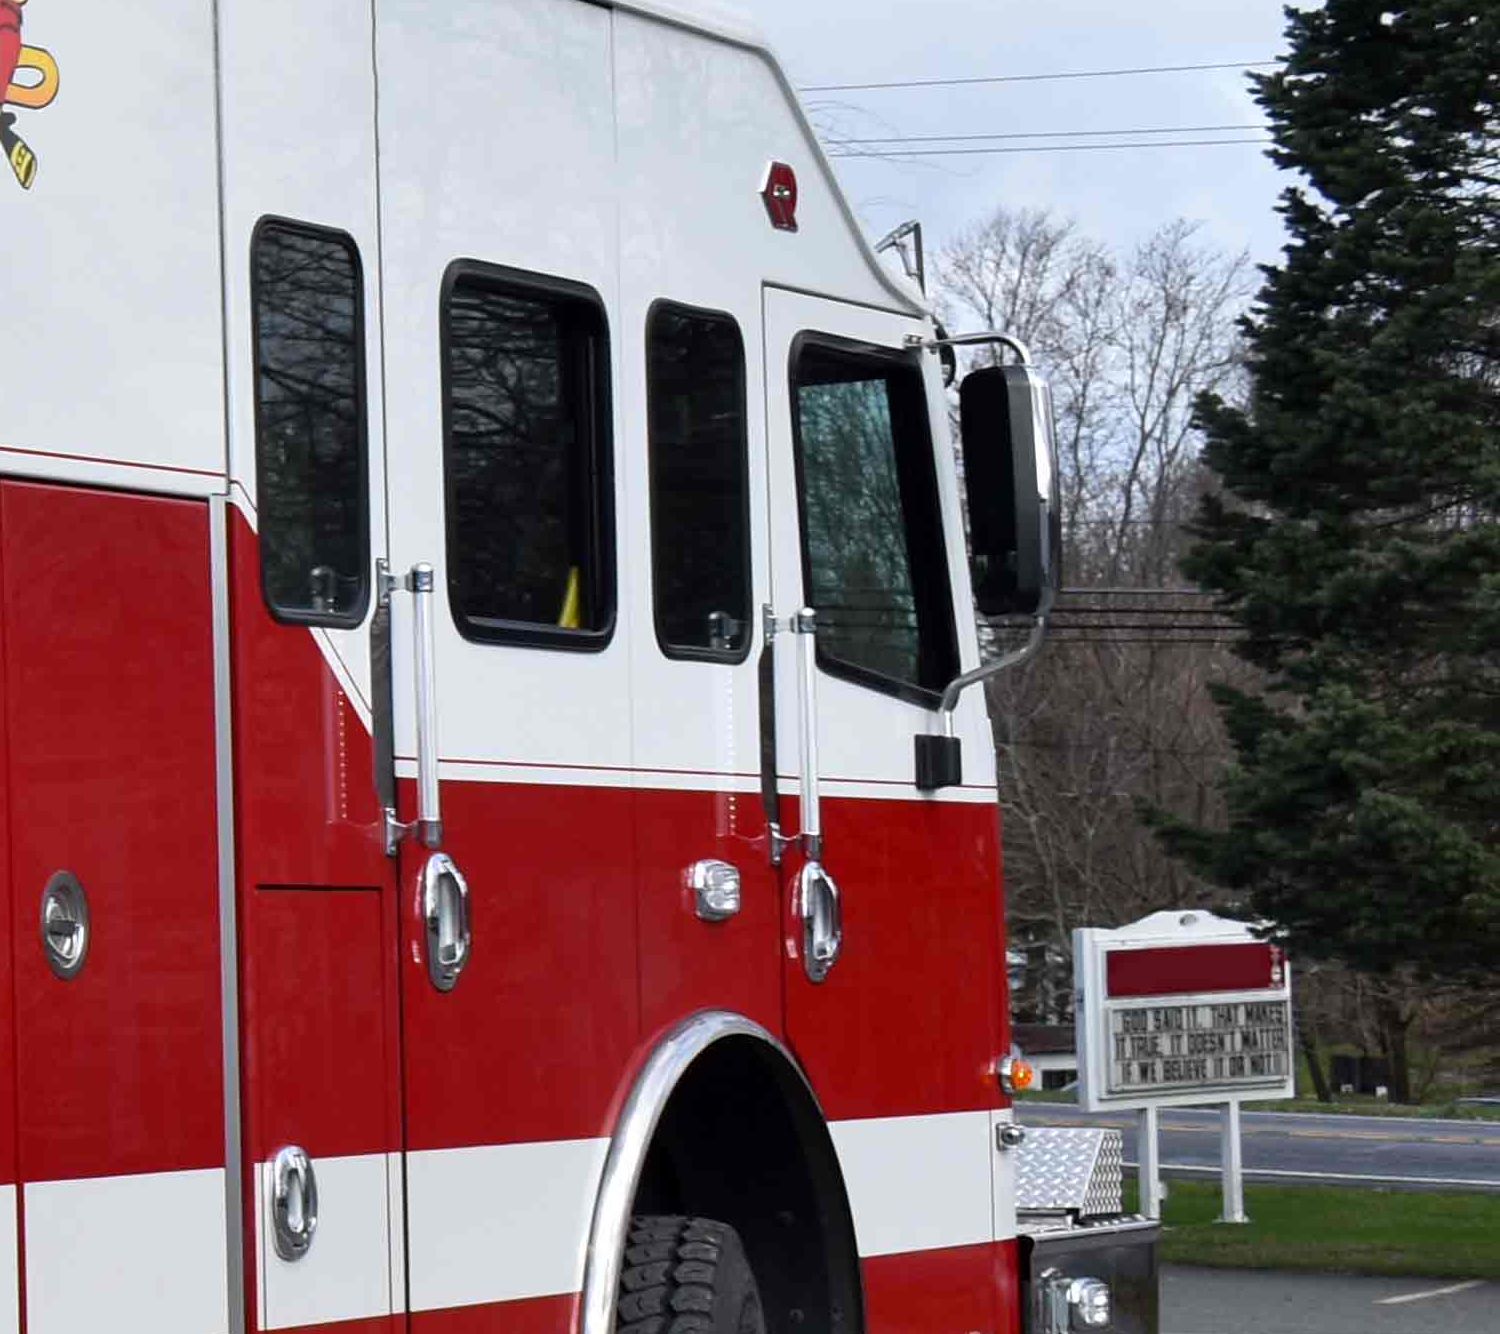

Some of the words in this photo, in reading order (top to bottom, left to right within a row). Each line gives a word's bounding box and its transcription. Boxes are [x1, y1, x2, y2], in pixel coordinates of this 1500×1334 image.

[1123, 1009, 1147, 1032] GOD
[1153, 1007, 1183, 1031] SAID
[1212, 1004, 1238, 1028] THAT
[1245, 1002, 1284, 1026] MAKES
[1170, 1033, 1182, 1056] IT
[1241, 1027, 1284, 1051] MATTER
[1138, 1061, 1156, 1083] WE
[1163, 1058, 1207, 1081] BELIEVE
[1213, 1057, 1224, 1078] IT
[1229, 1055, 1244, 1077] OR
